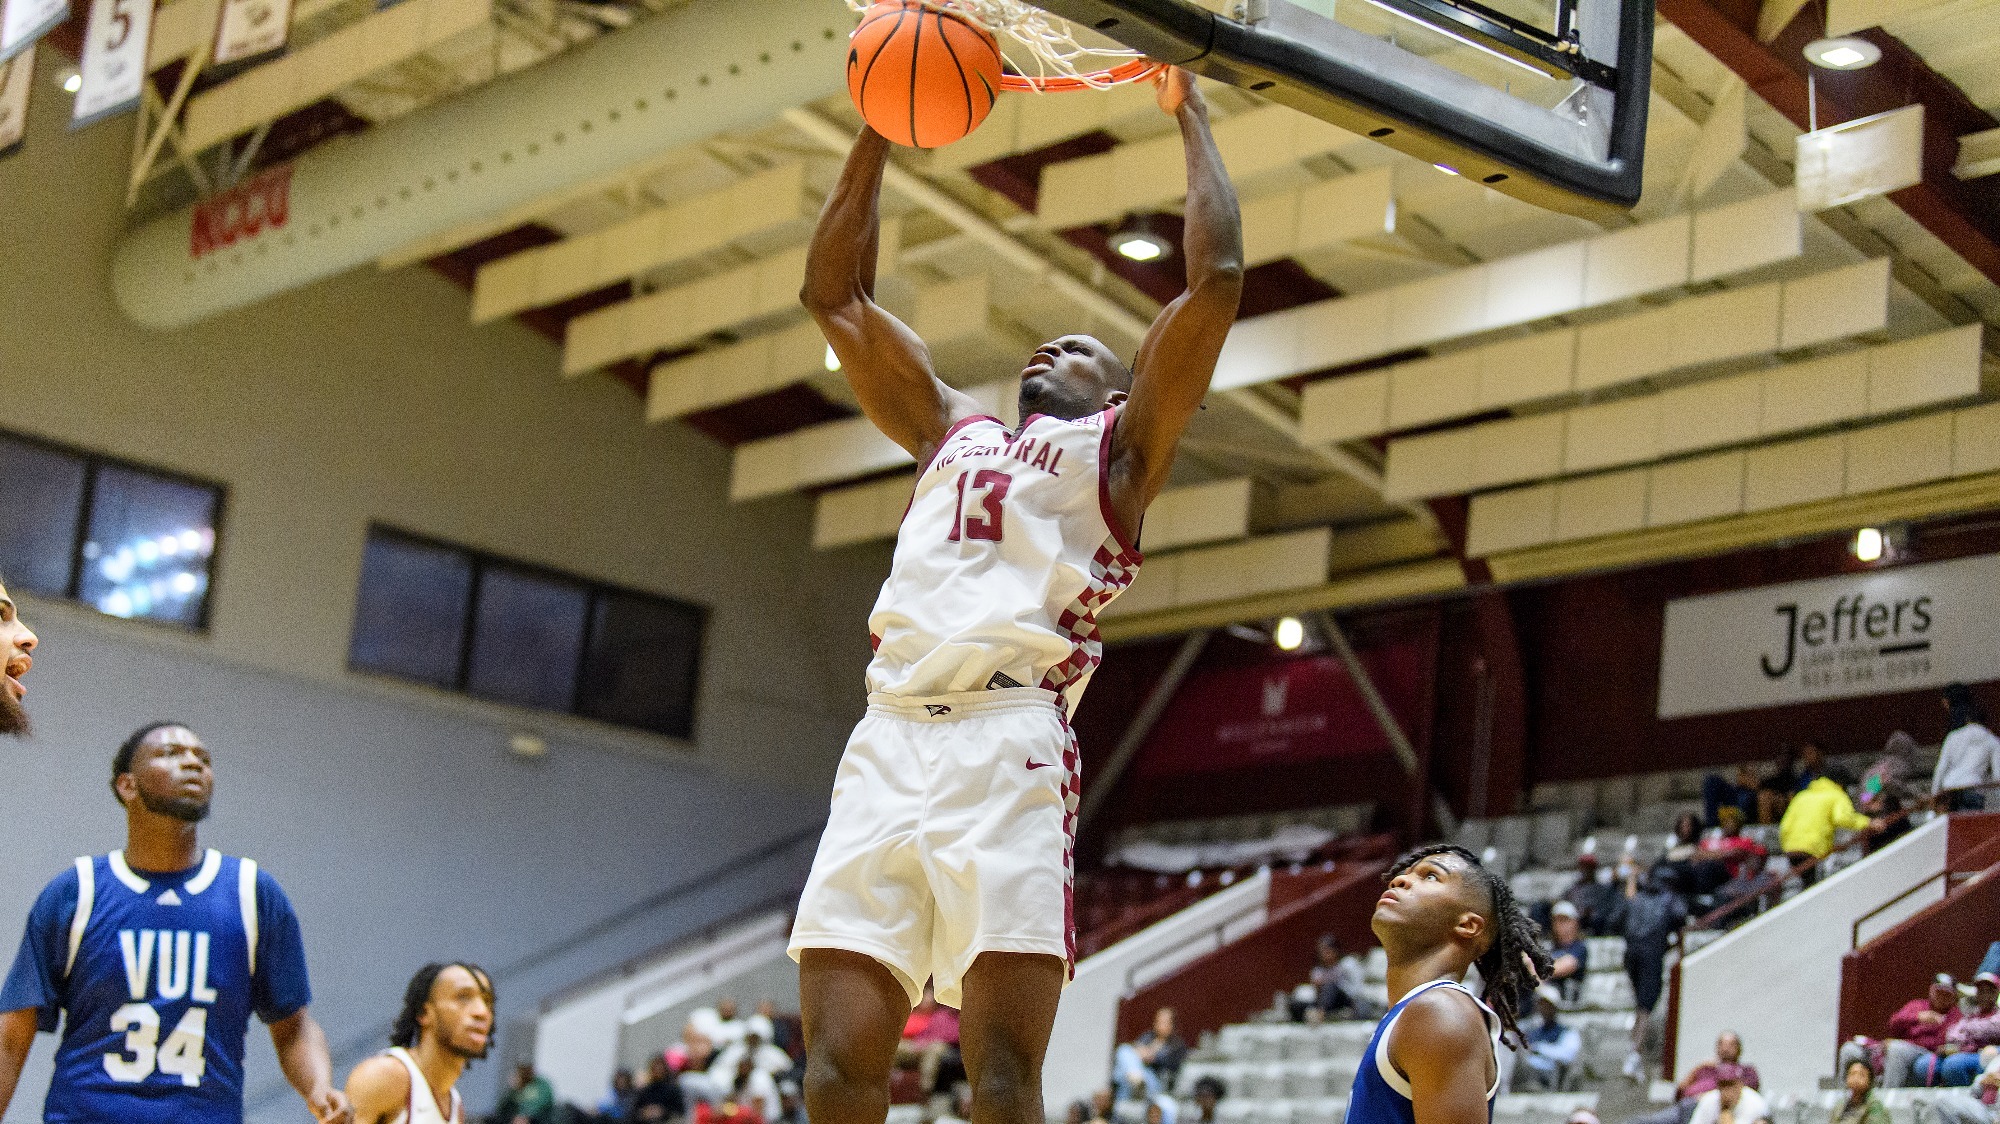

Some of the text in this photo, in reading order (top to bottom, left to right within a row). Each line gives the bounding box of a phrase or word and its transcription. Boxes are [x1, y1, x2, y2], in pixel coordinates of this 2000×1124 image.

[107, 0, 133, 51] 5
[945, 468, 1014, 544] 13
[1760, 594, 1932, 680] Jeffers
[118, 929, 217, 1002] VUL
[103, 1003, 206, 1087] 34
